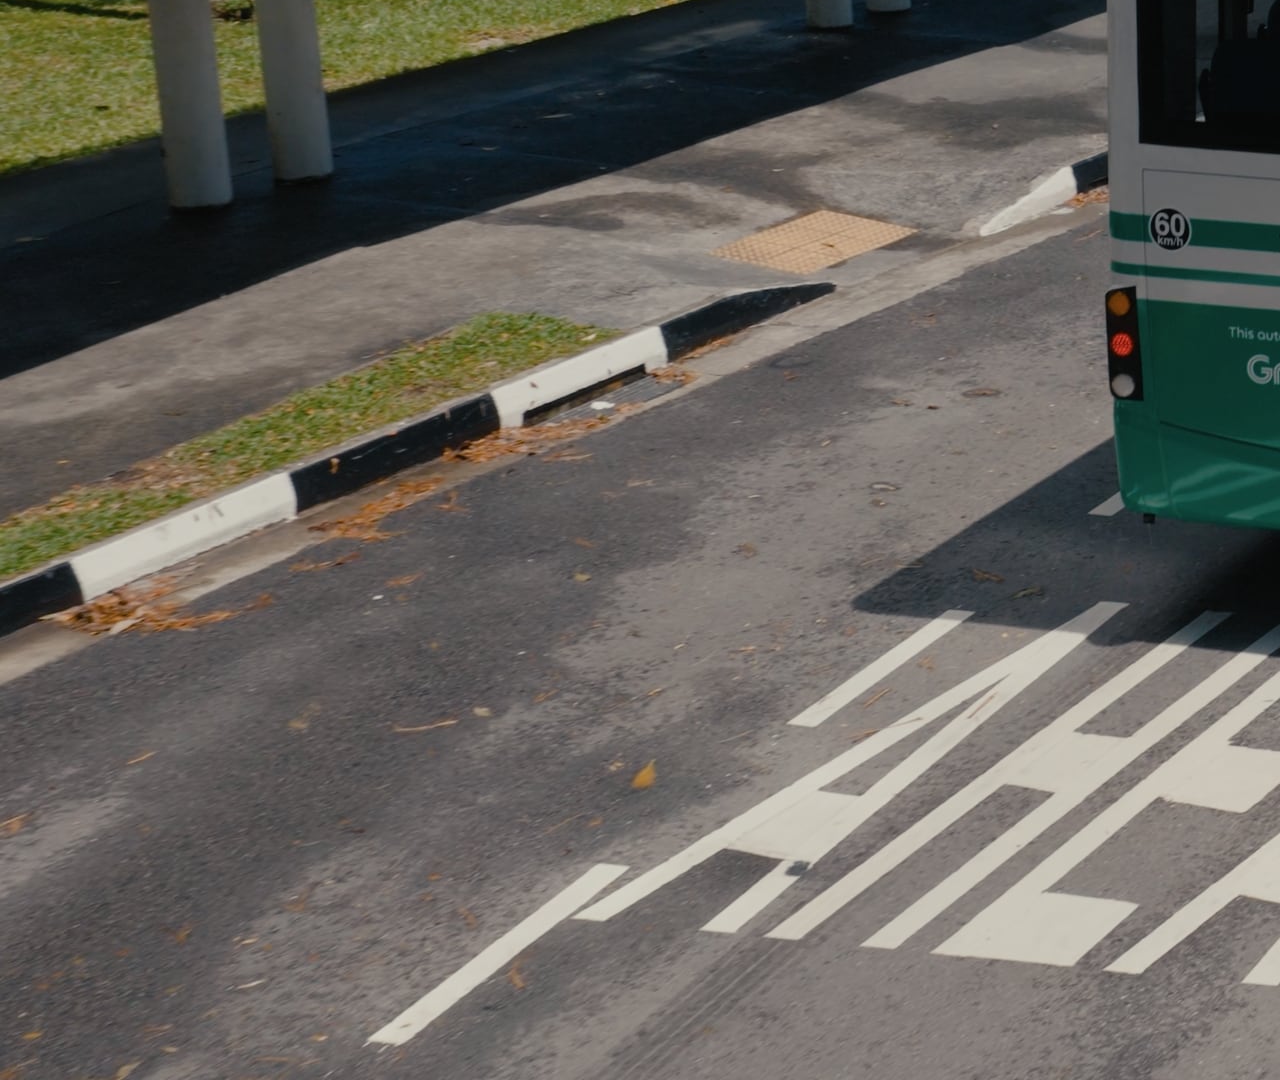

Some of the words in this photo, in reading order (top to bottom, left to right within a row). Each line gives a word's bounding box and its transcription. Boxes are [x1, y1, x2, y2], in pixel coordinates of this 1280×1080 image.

[1155, 212, 1185, 237] 60
[1157, 234, 1183, 247] km/h
[1228, 326, 1254, 340] This
